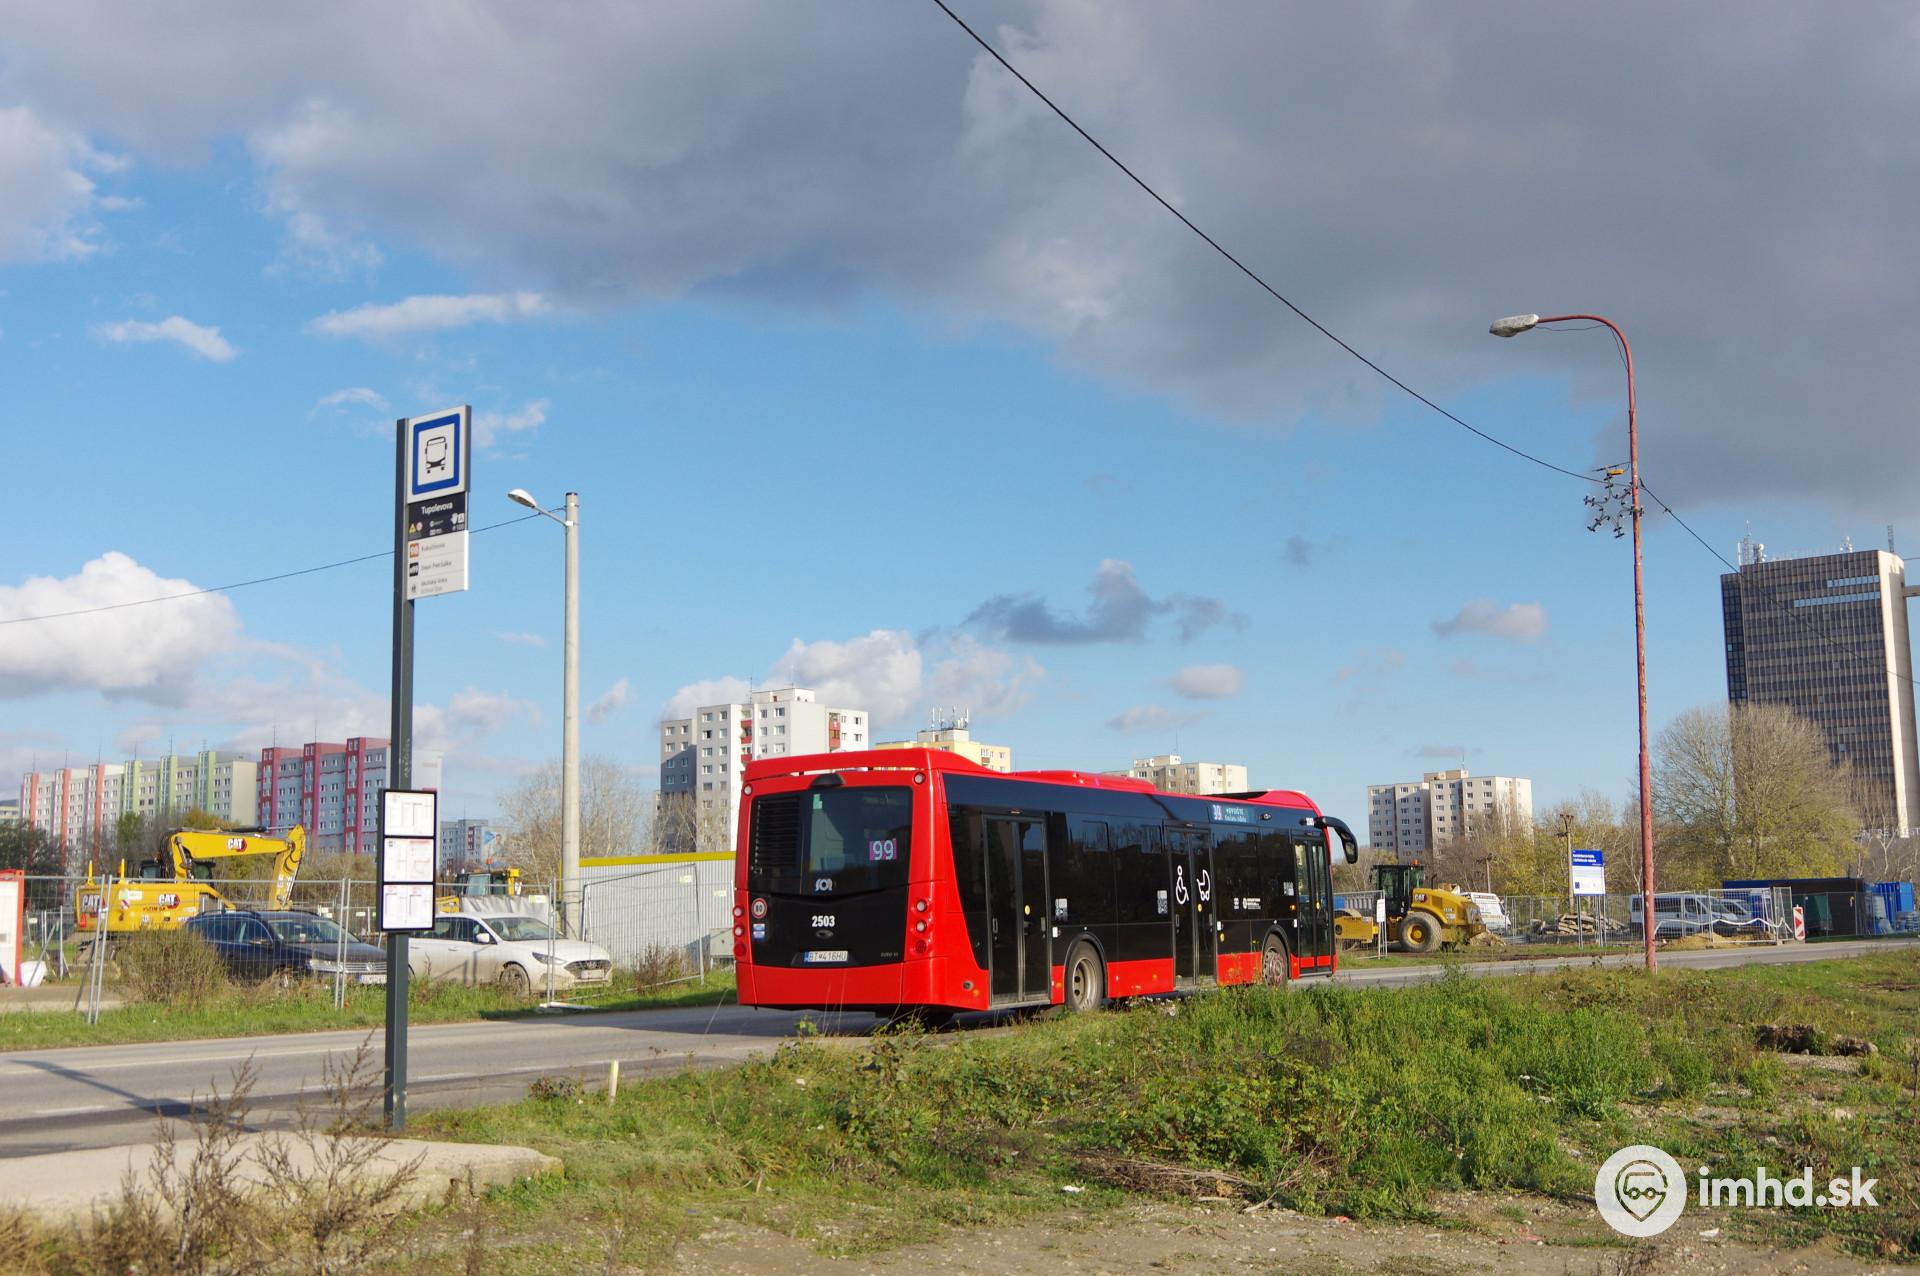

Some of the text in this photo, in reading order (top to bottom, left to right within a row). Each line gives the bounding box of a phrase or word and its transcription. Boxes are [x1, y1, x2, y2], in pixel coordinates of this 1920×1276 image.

[422, 502, 453, 514] Tupolevova
[227, 838, 243, 850] CAT
[873, 840, 894, 861] 99
[82, 895, 100, 909] CAT
[158, 893, 175, 905] CAT
[811, 915, 835, 927] 2503
